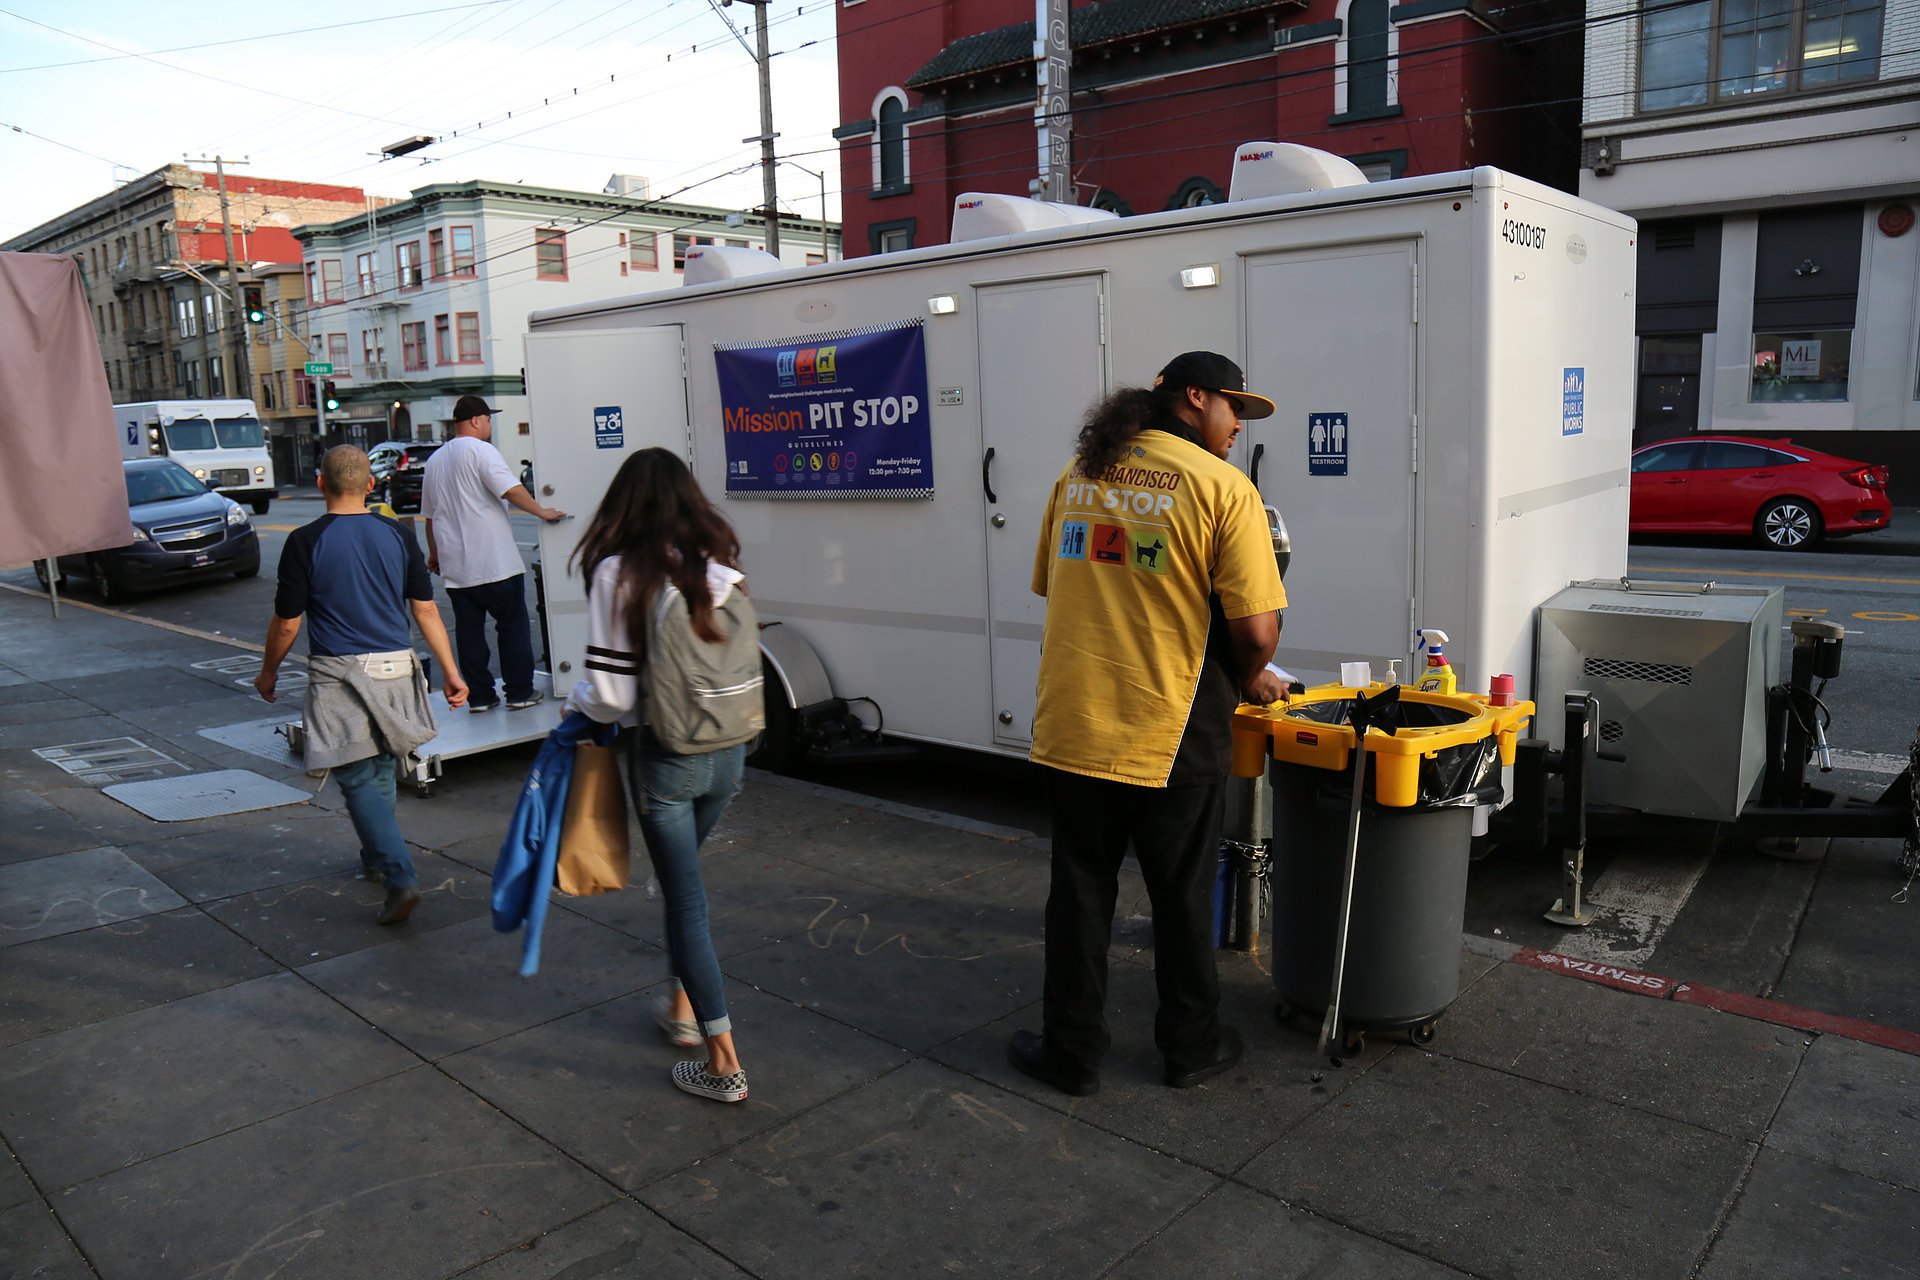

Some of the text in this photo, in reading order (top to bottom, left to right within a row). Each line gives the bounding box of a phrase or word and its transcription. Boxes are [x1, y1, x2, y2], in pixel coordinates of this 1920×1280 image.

[1502, 218, 1546, 250] 43100187
[724, 395, 919, 433] Mission PIT STOP
[1564, 402, 1583, 415] PUBLIC
[1563, 416, 1583, 431] WORKS
[788, 440, 843, 449] GUIDELINES
[876, 457, 921, 466] Monday-Friday
[1066, 483, 1174, 517] PIT STOP
[1420, 681, 1440, 692] Lysol
[1562, 957, 1666, 989] SFMTA
